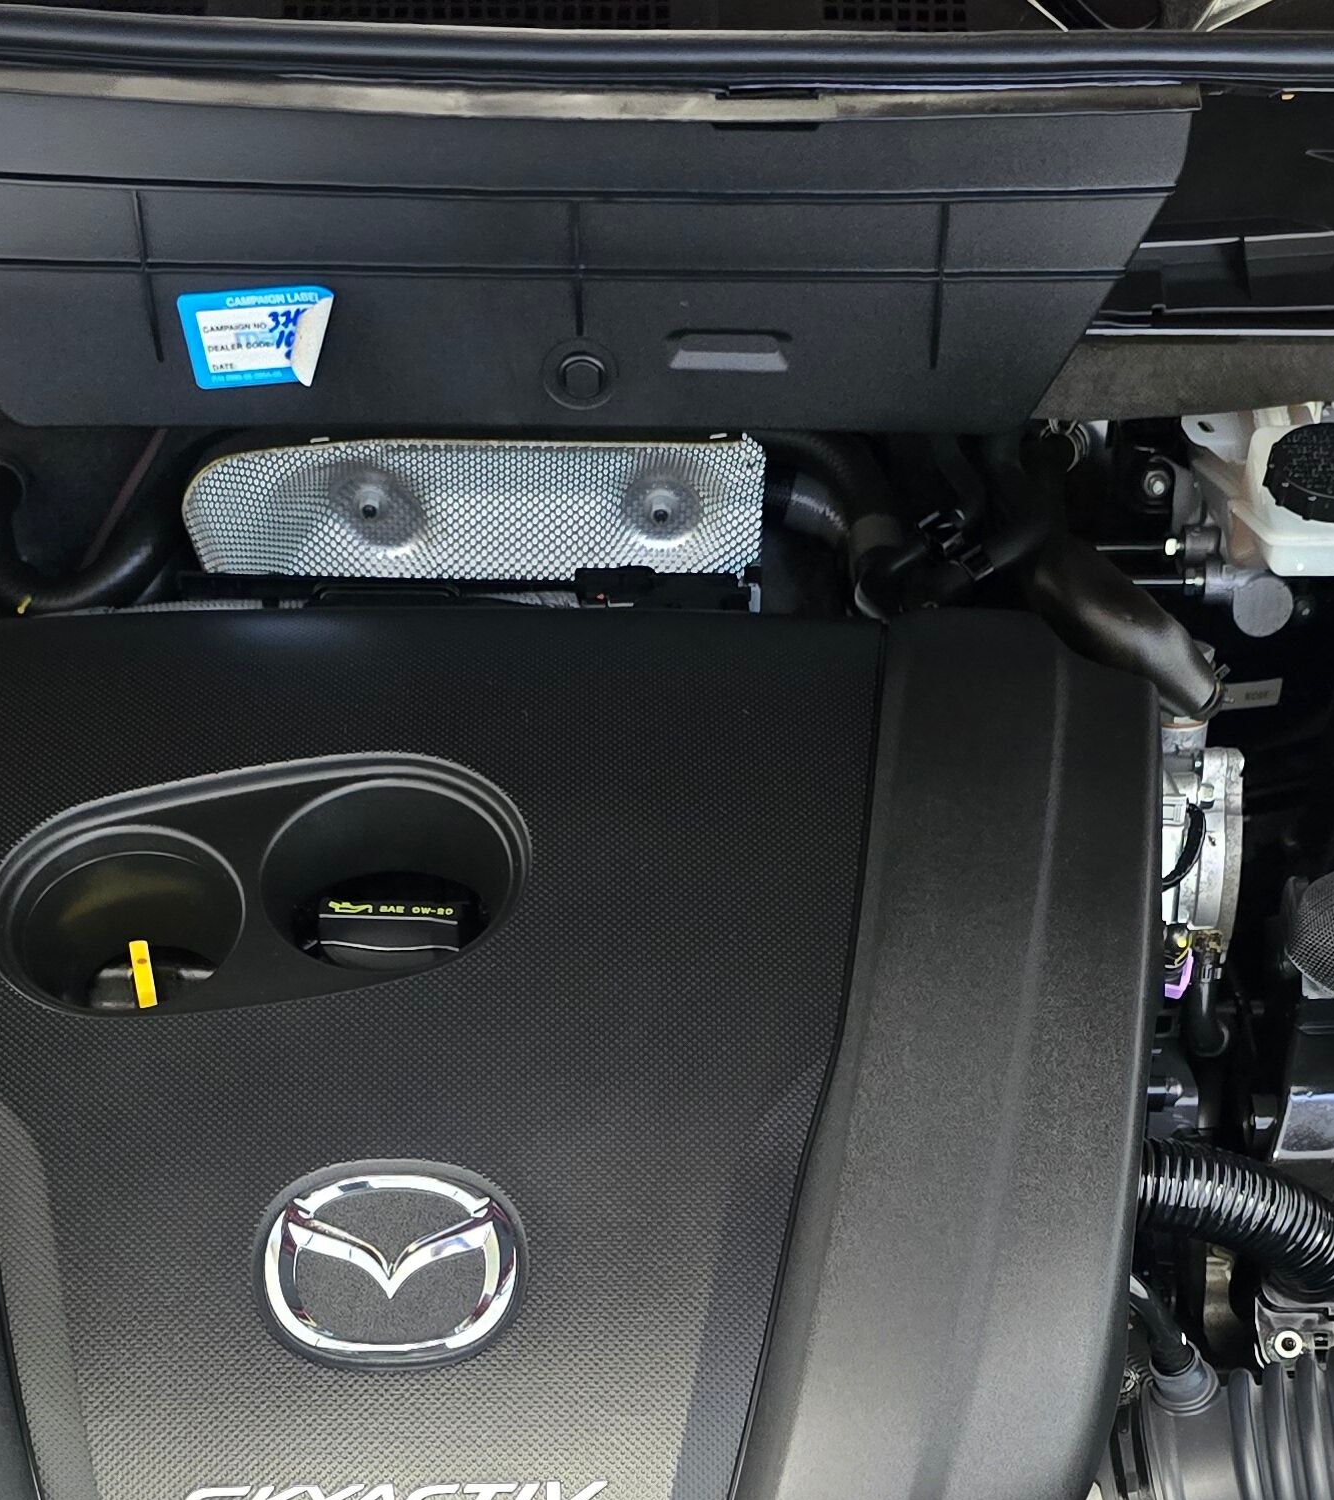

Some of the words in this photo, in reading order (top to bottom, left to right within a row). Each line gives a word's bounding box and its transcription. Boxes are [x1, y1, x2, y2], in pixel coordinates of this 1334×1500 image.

[225, 294, 285, 307] CAMPAIGN
[203, 323, 251, 334] CAMPAIGN
[207, 341, 243, 353] DEALER
[379, 905, 406, 914] SAE
